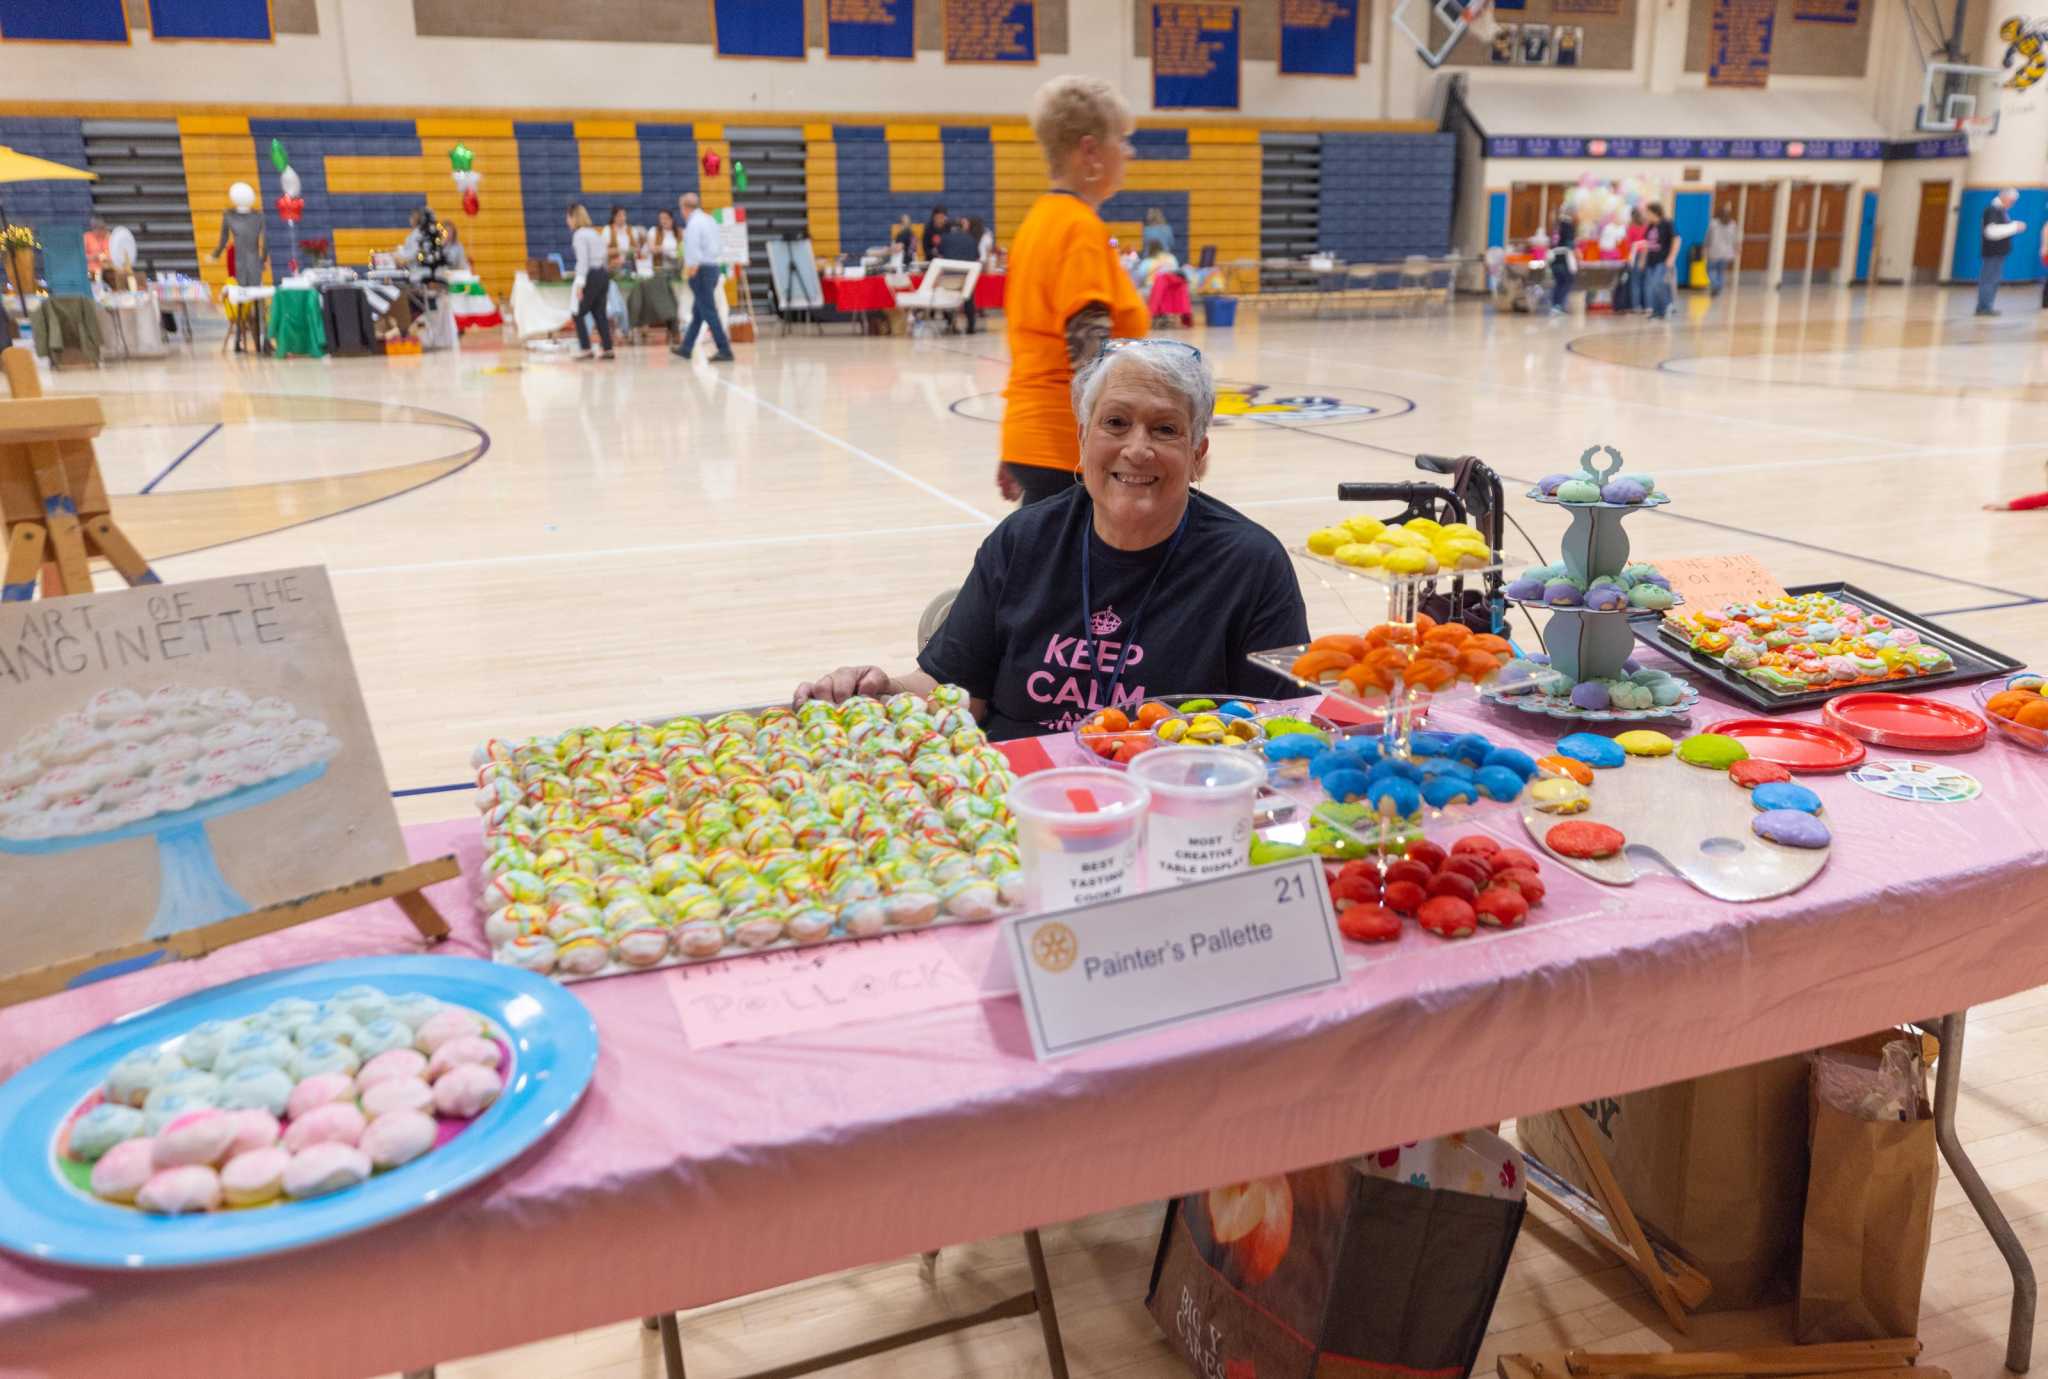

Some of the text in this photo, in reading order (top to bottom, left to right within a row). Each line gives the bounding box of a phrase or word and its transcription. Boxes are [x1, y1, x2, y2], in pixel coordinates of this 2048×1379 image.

[20, 576, 303, 641] ART OF THE
[1043, 633, 1144, 674] KEEP
[1026, 670, 1147, 711] CALM
[1175, 847, 1233, 859] CREATIVE
[1187, 835, 1222, 847] MOST
[1070, 869, 1124, 888] TASTING
[1081, 857, 1114, 873] BEST
[1159, 857, 1243, 873] TABLE DISPLAY
[1275, 875, 1306, 904] 21
[1083, 920, 1274, 982] Painter's Pallette
[691, 958, 945, 1023] POLLOCK
